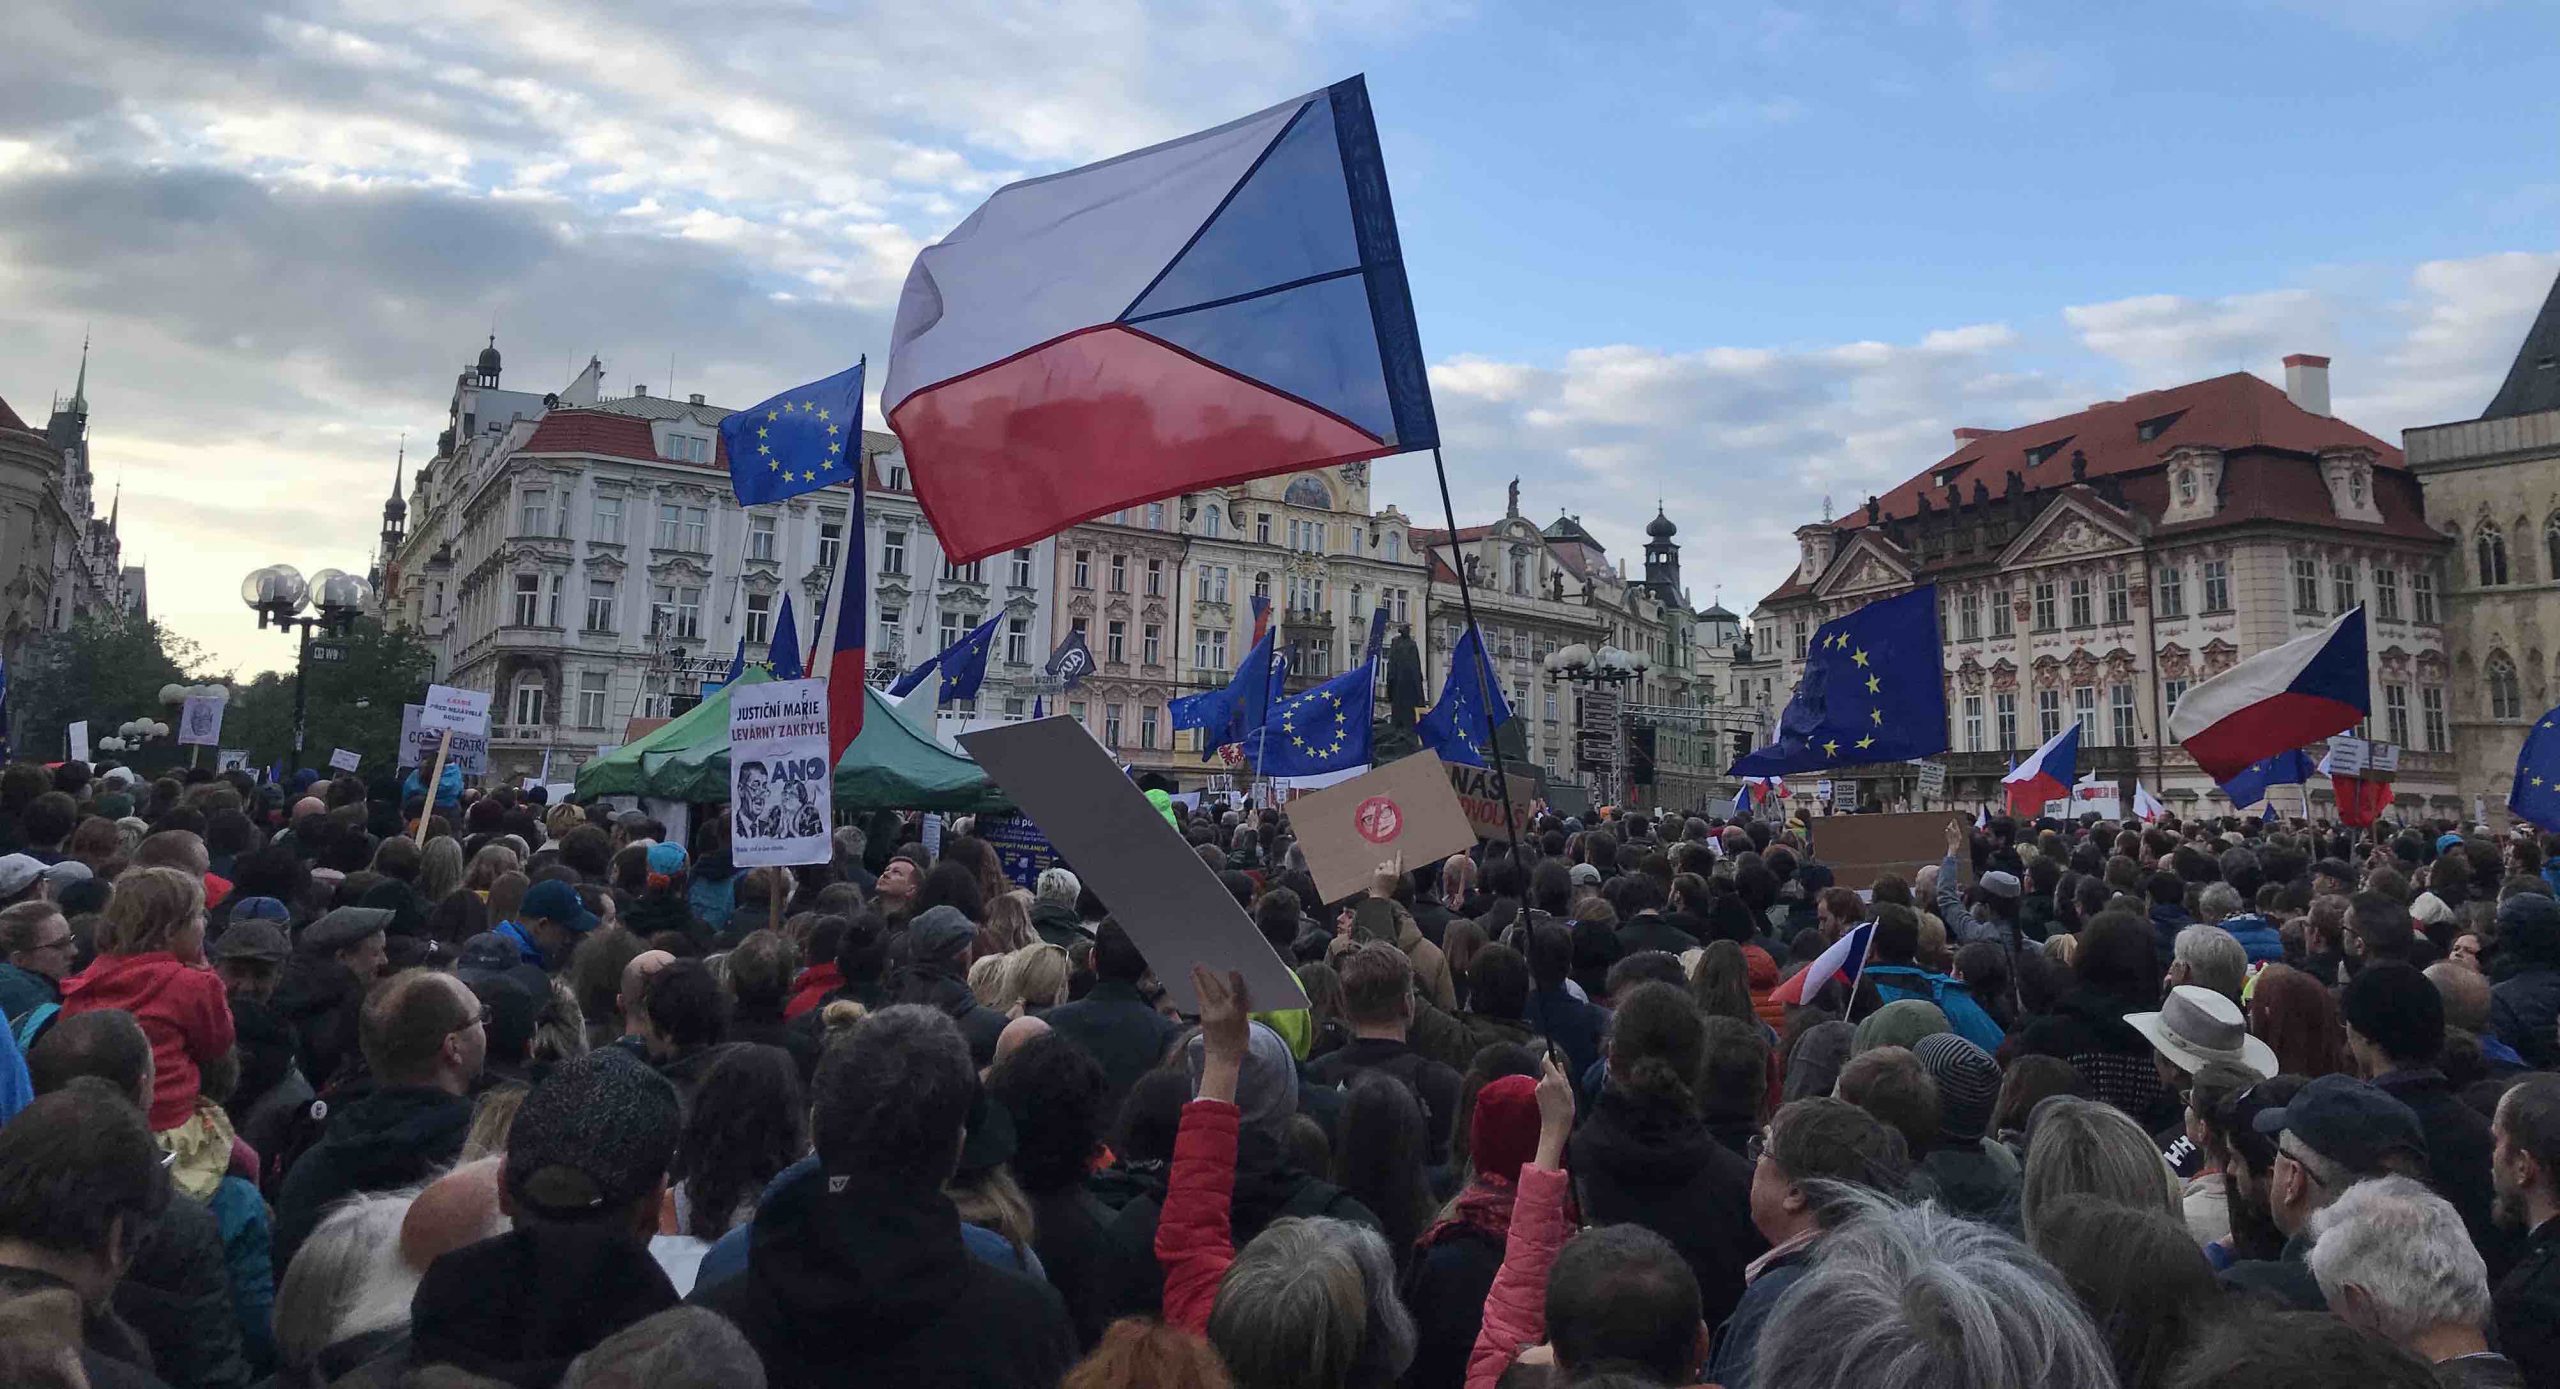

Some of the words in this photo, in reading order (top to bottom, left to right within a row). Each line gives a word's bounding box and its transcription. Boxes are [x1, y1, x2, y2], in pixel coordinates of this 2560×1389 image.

[737, 700, 780, 721] JUSTIČNÍ
[731, 724, 775, 741] LEVÁRNY
[778, 722, 827, 738] ZAKRYJE
[771, 757, 826, 783] ANO
